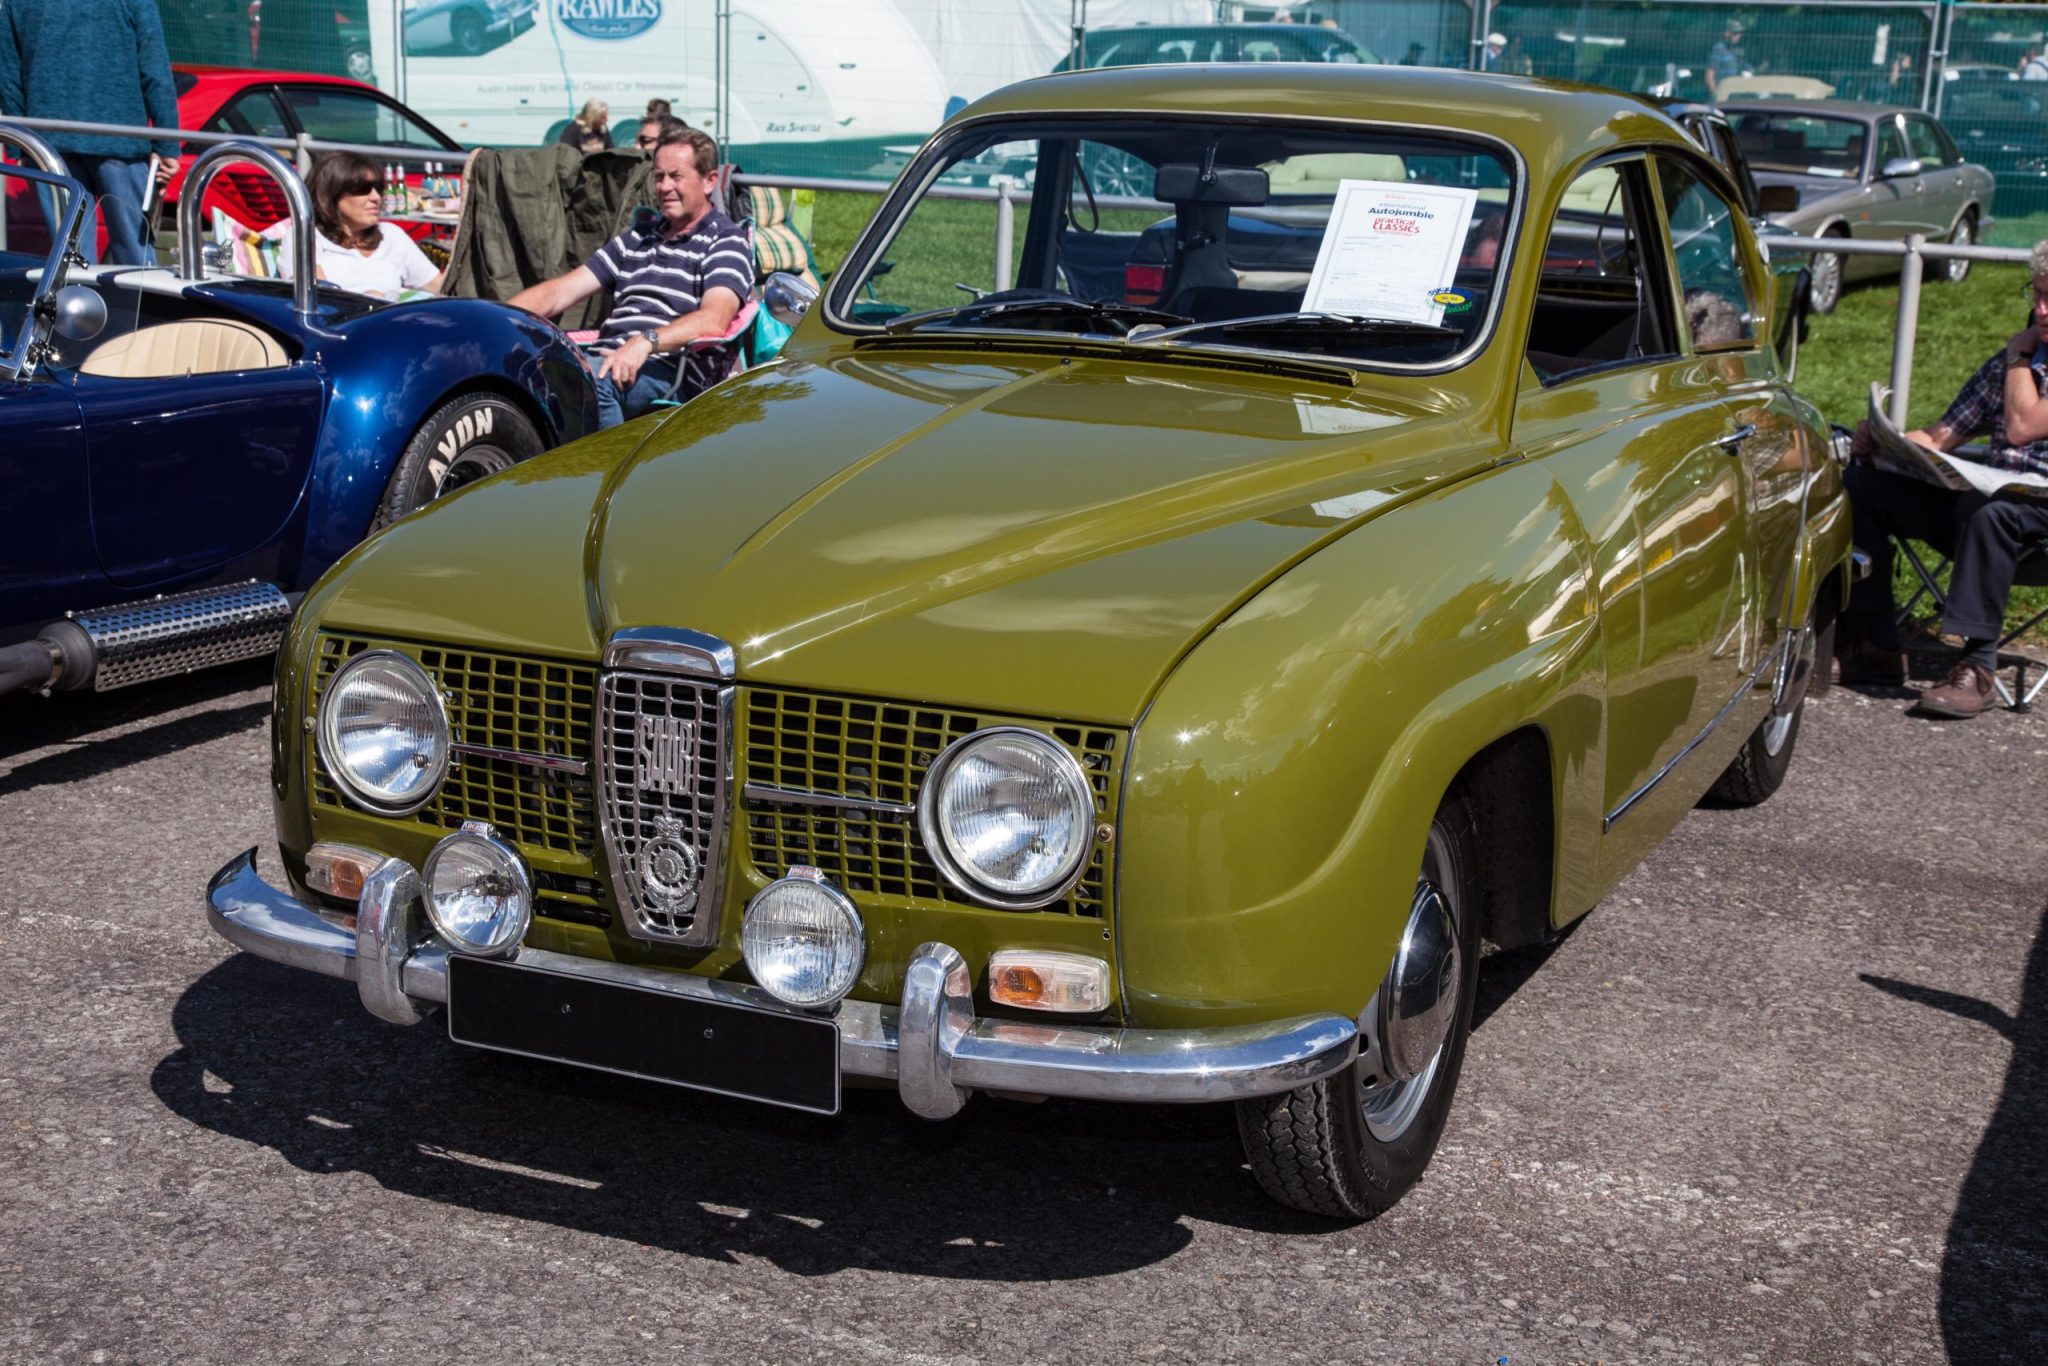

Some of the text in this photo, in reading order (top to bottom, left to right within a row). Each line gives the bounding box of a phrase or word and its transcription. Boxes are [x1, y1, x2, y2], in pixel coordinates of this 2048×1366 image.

[1368, 207, 1434, 219] Autojumble
[1373, 223, 1420, 233] CLASSICS
[1374, 218, 1416, 226] practical
[428, 407, 493, 487] AVON
[638, 716, 695, 795] SAAB
